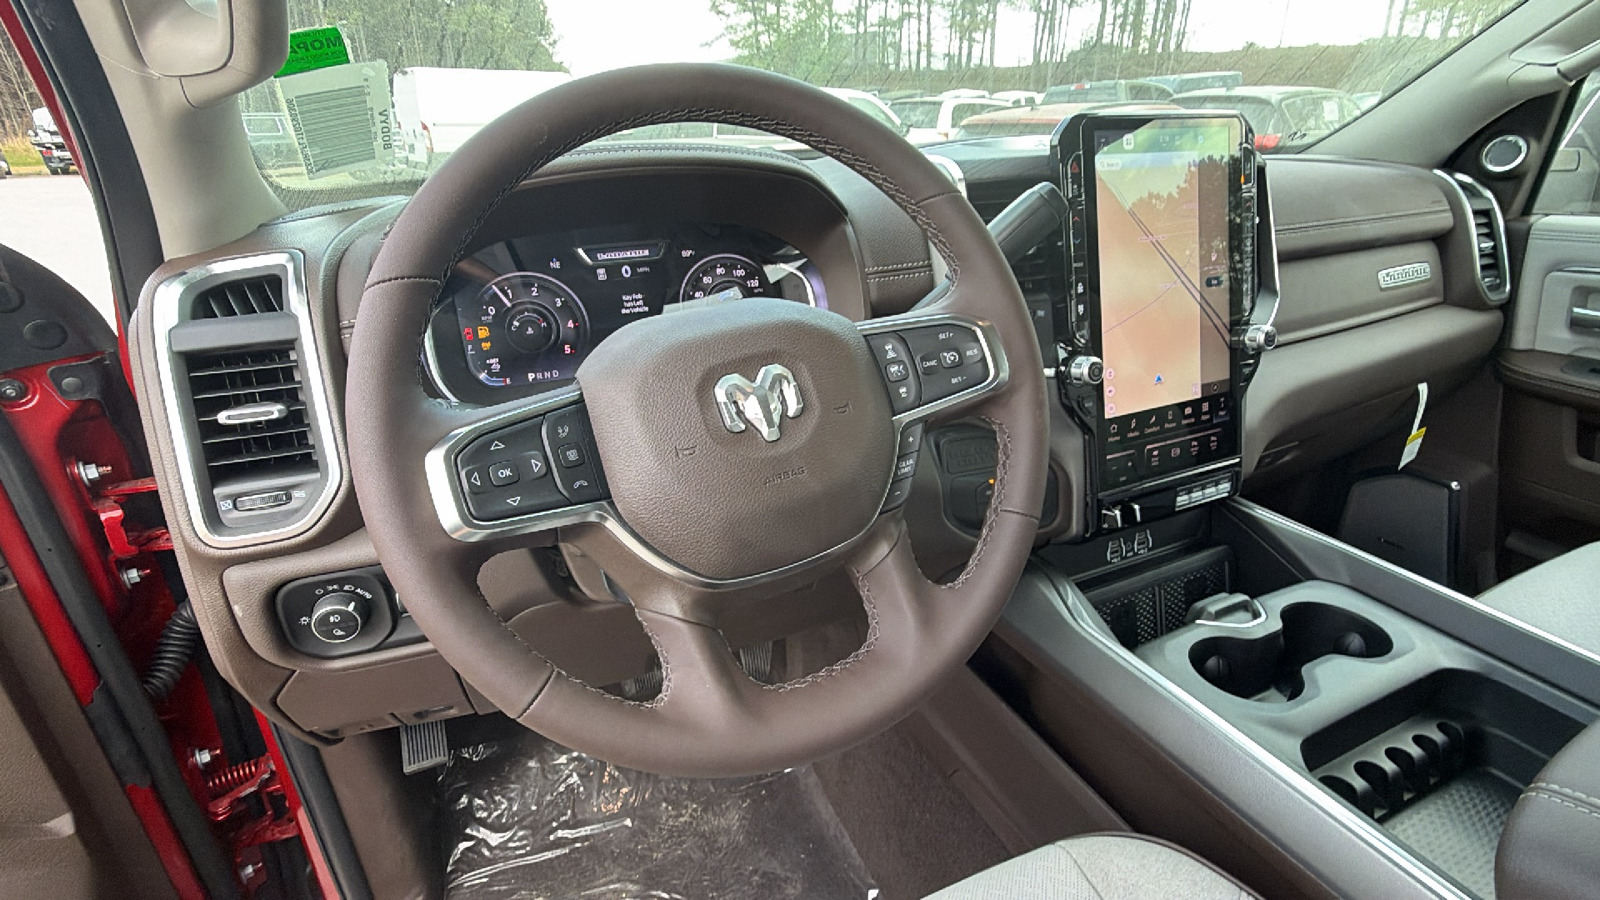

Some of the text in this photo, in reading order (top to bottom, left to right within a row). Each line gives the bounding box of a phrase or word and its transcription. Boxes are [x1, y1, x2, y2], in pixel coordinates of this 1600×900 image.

[550, 261, 561, 269] NE
[621, 265, 632, 278] 0
[716, 267, 726, 275] 80
[733, 269, 746, 277] 100
[702, 276, 713, 284] 60
[746, 280, 759, 288] 120
[506, 289, 513, 299] 1
[531, 287, 539, 296] 2
[555, 298, 562, 307] 3
[488, 306, 496, 316] 0
[567, 320, 574, 328] 4
[564, 345, 571, 354] 5
[922, 360, 938, 368] CANC
[498, 468, 513, 478] OK
[764, 466, 806, 486] AIRBAG
[355, 588, 372, 599] AUTO
